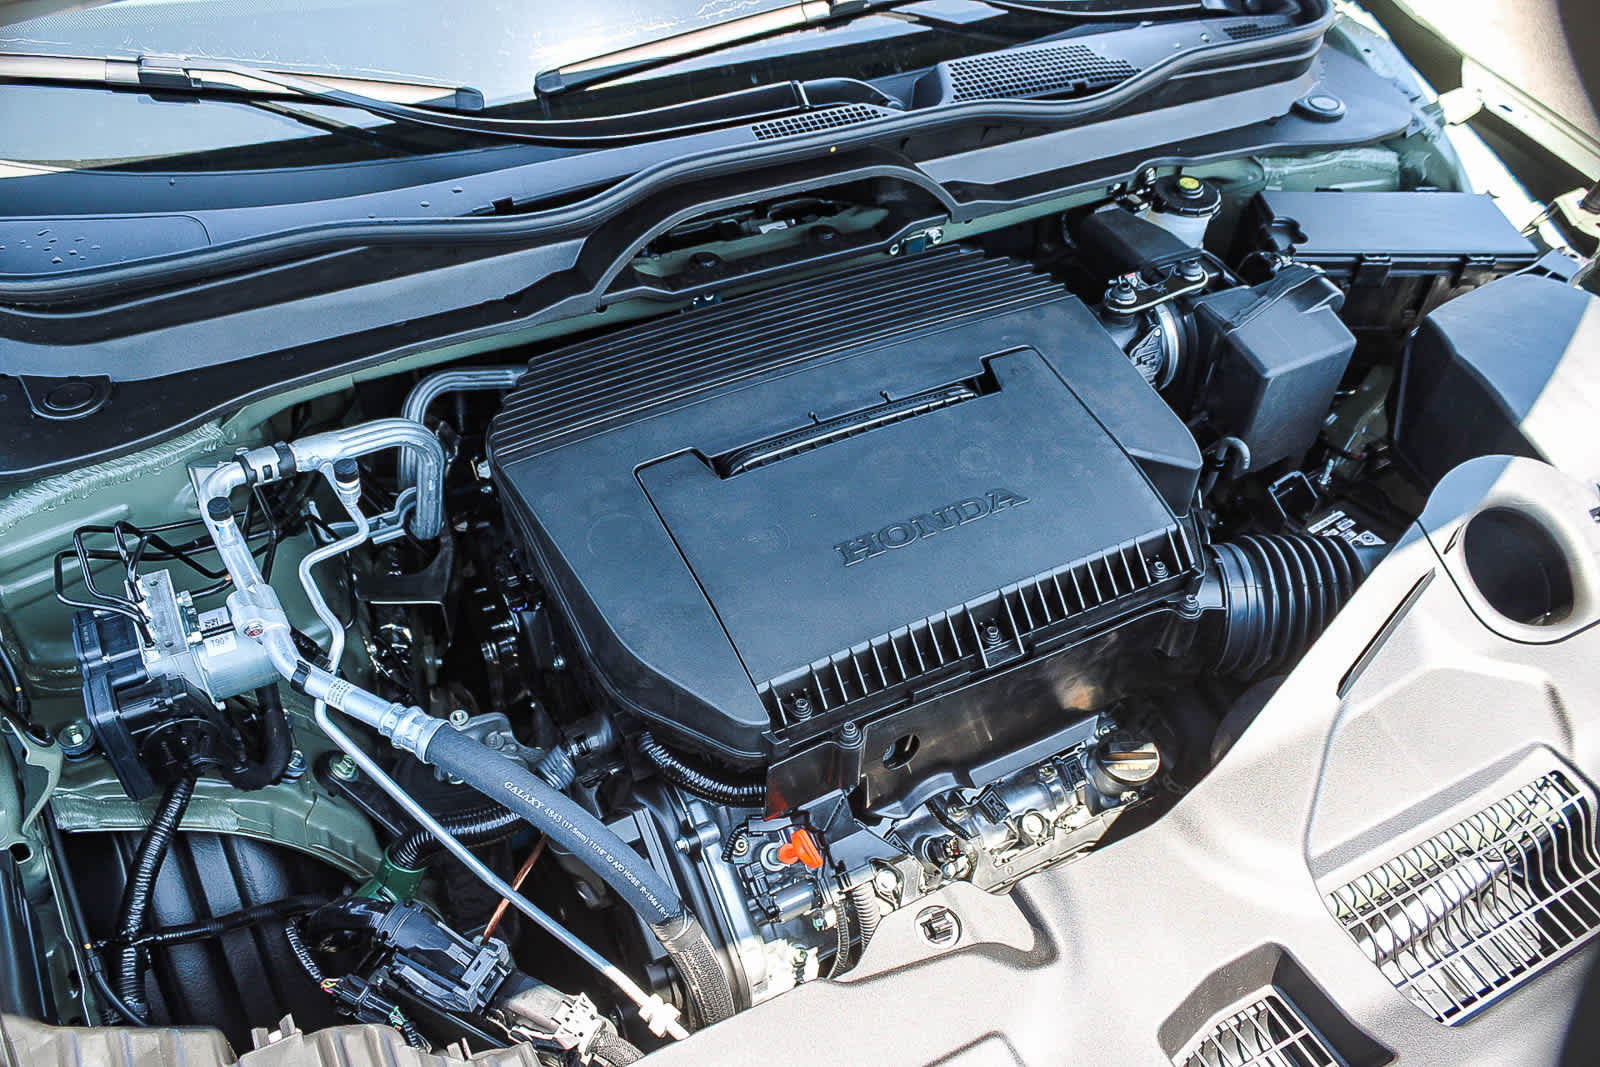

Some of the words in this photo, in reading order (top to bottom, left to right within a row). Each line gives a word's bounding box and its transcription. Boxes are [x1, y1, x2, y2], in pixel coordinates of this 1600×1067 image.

[834, 487, 1031, 567] HONDA
[504, 781, 545, 809] GALAXY
[544, 807, 562, 824] 4843
[623, 869, 641, 888] HOSE
